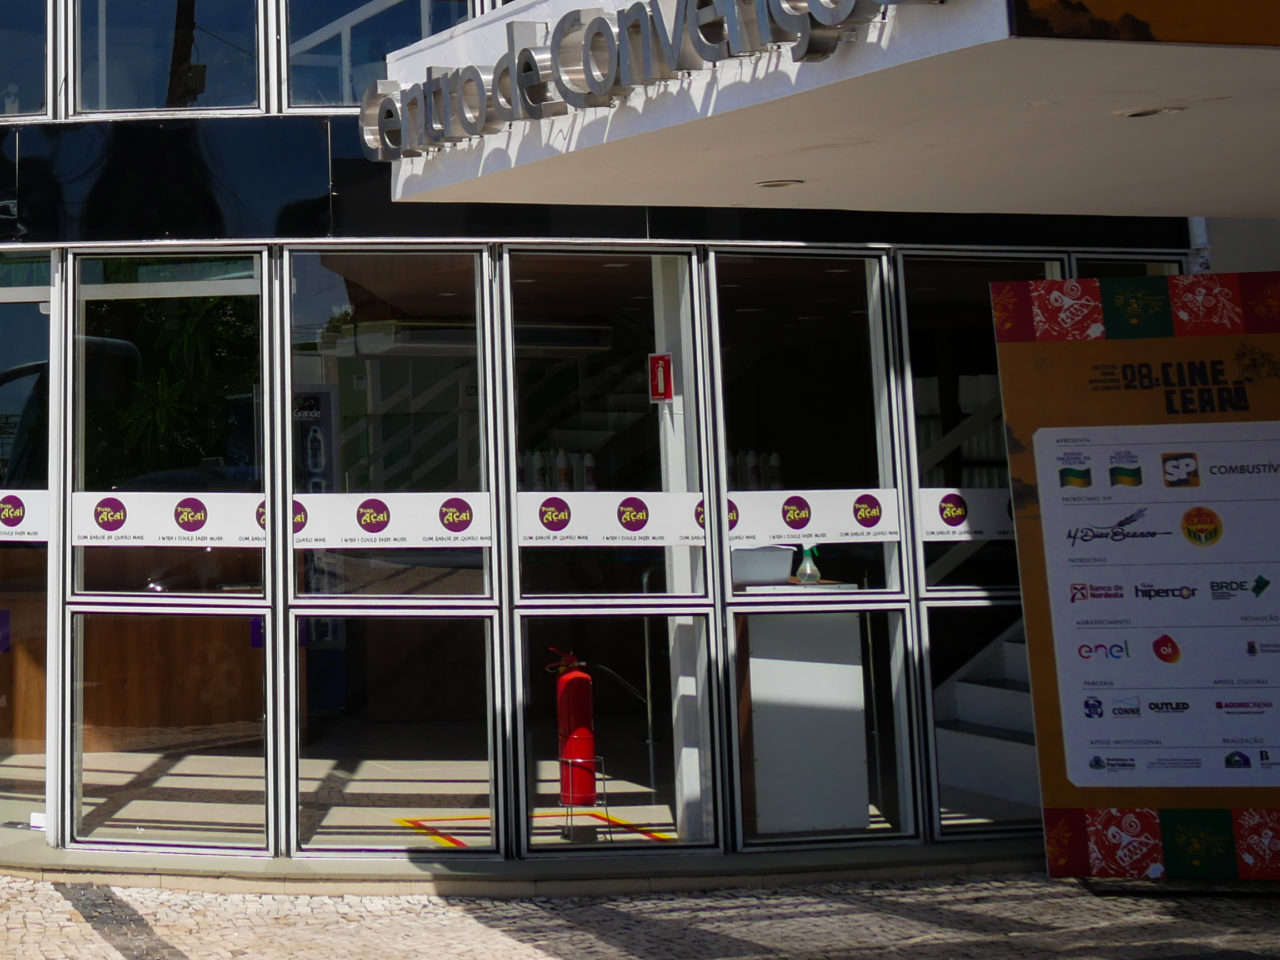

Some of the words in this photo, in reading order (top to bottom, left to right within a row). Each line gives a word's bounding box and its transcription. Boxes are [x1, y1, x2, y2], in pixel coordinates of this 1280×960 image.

[359, 65, 489, 162] Centro
[492, 22, 568, 122] de
[1161, 360, 1228, 387] CINE
[1210, 581, 1249, 591] BRDE
[1078, 639, 1131, 659] enel
[1148, 702, 1190, 710] OUTLED
